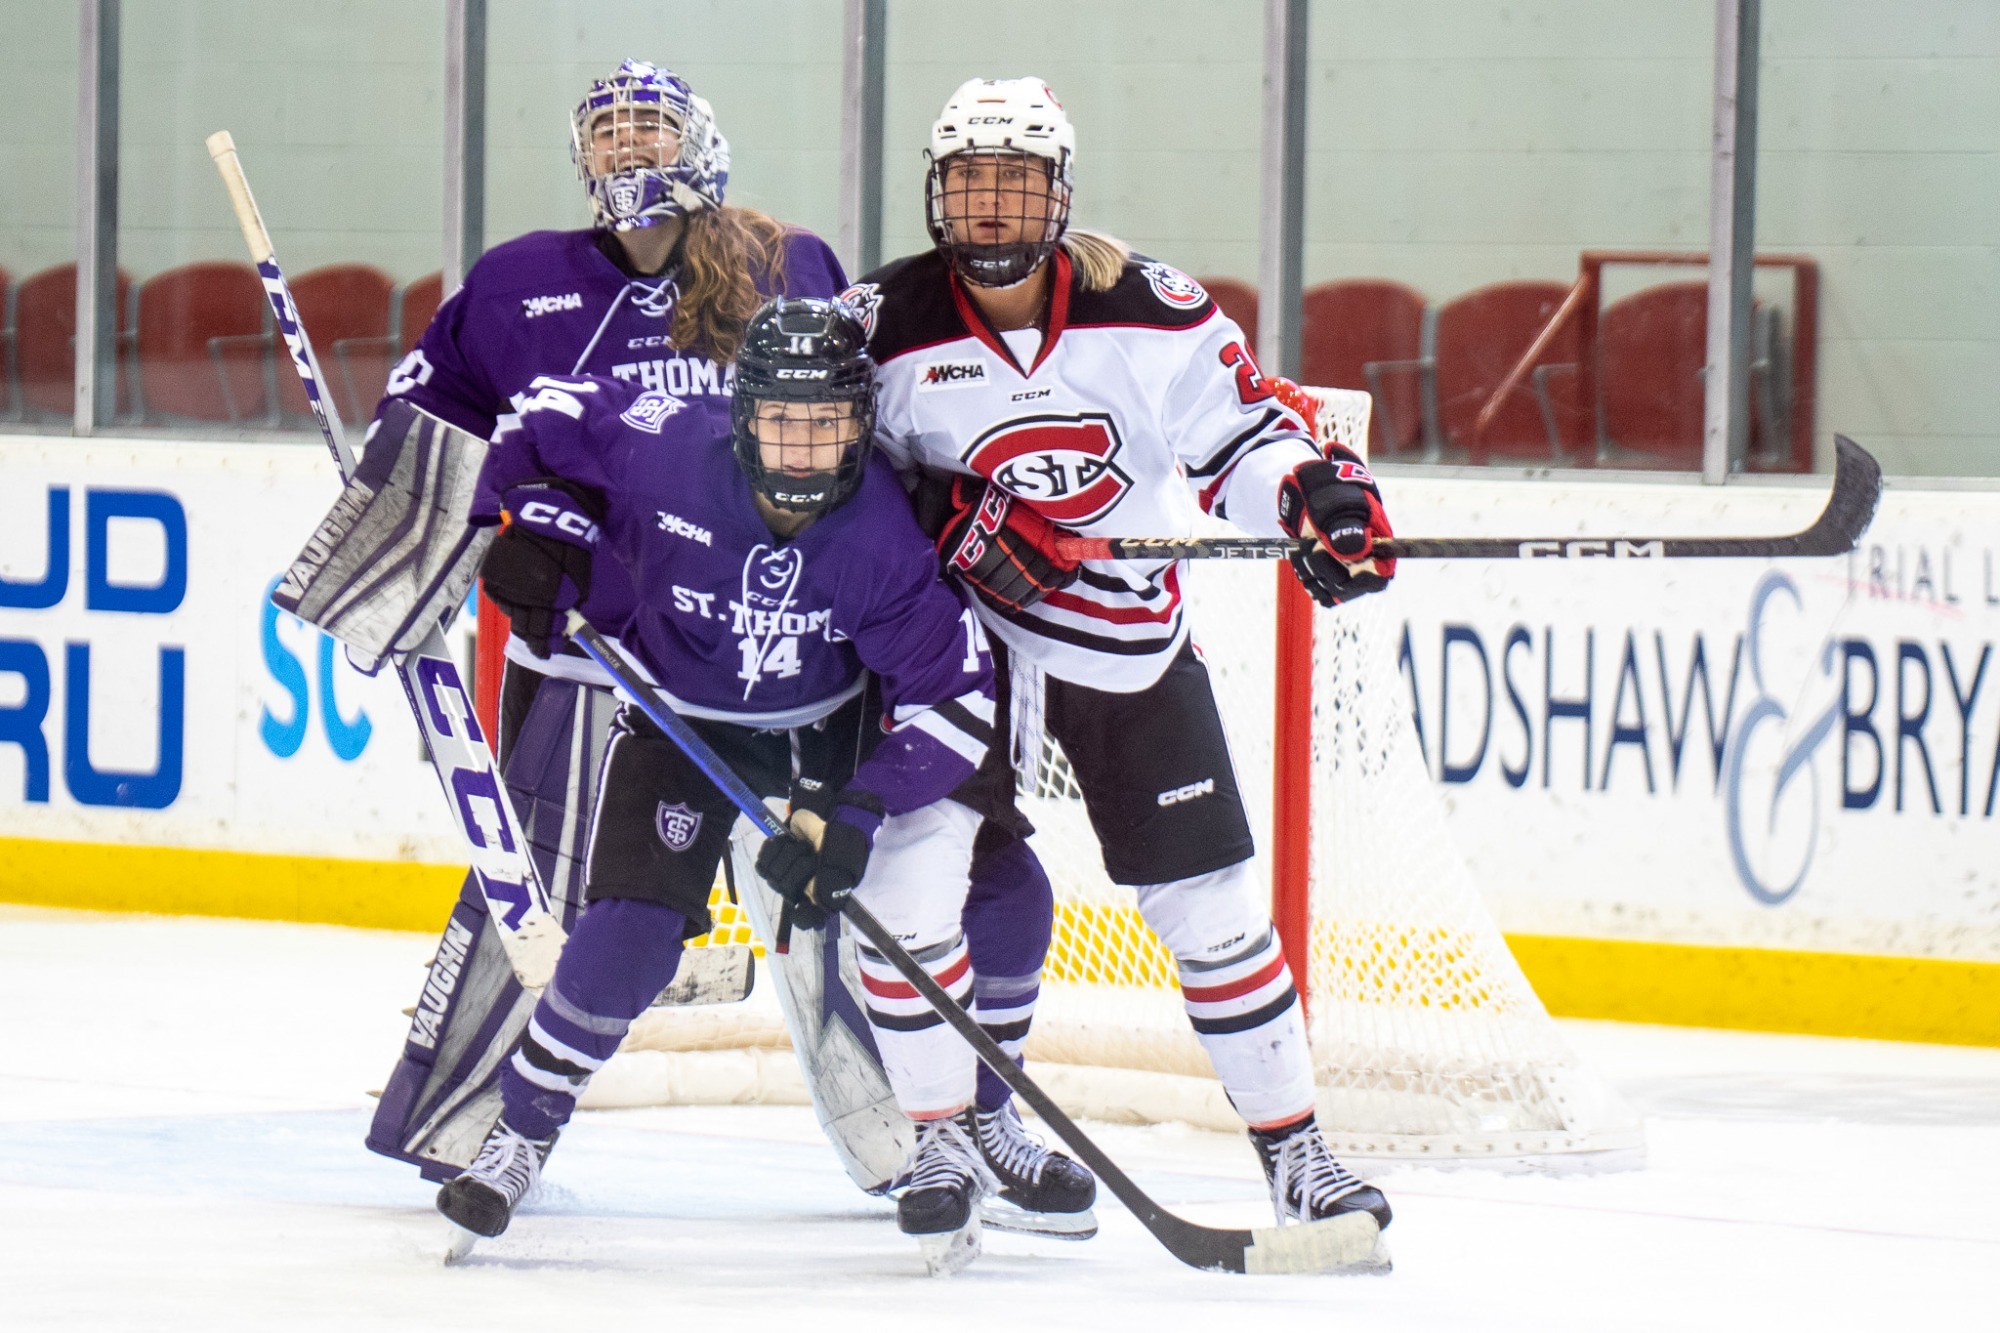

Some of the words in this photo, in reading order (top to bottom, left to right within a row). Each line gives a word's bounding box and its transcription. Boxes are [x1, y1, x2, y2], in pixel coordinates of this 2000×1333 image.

[967, 116, 1014, 125] CCM
[789, 336, 813, 355] 14
[776, 368, 828, 379] CCM
[931, 363, 985, 384] WCHA
[1011, 388, 1052, 402] CCM
[774, 491, 825, 503] CCM
[948, 480, 1012, 572] CC
[274, 476, 375, 601] VAUGHN
[1208, 546, 1301, 560] JETS
[671, 584, 727, 622] ST.
[737, 637, 803, 682] 14
[1156, 777, 1215, 807] CCM
[891, 932, 918, 942] CM
[407, 916, 474, 1050] VAUGHN
